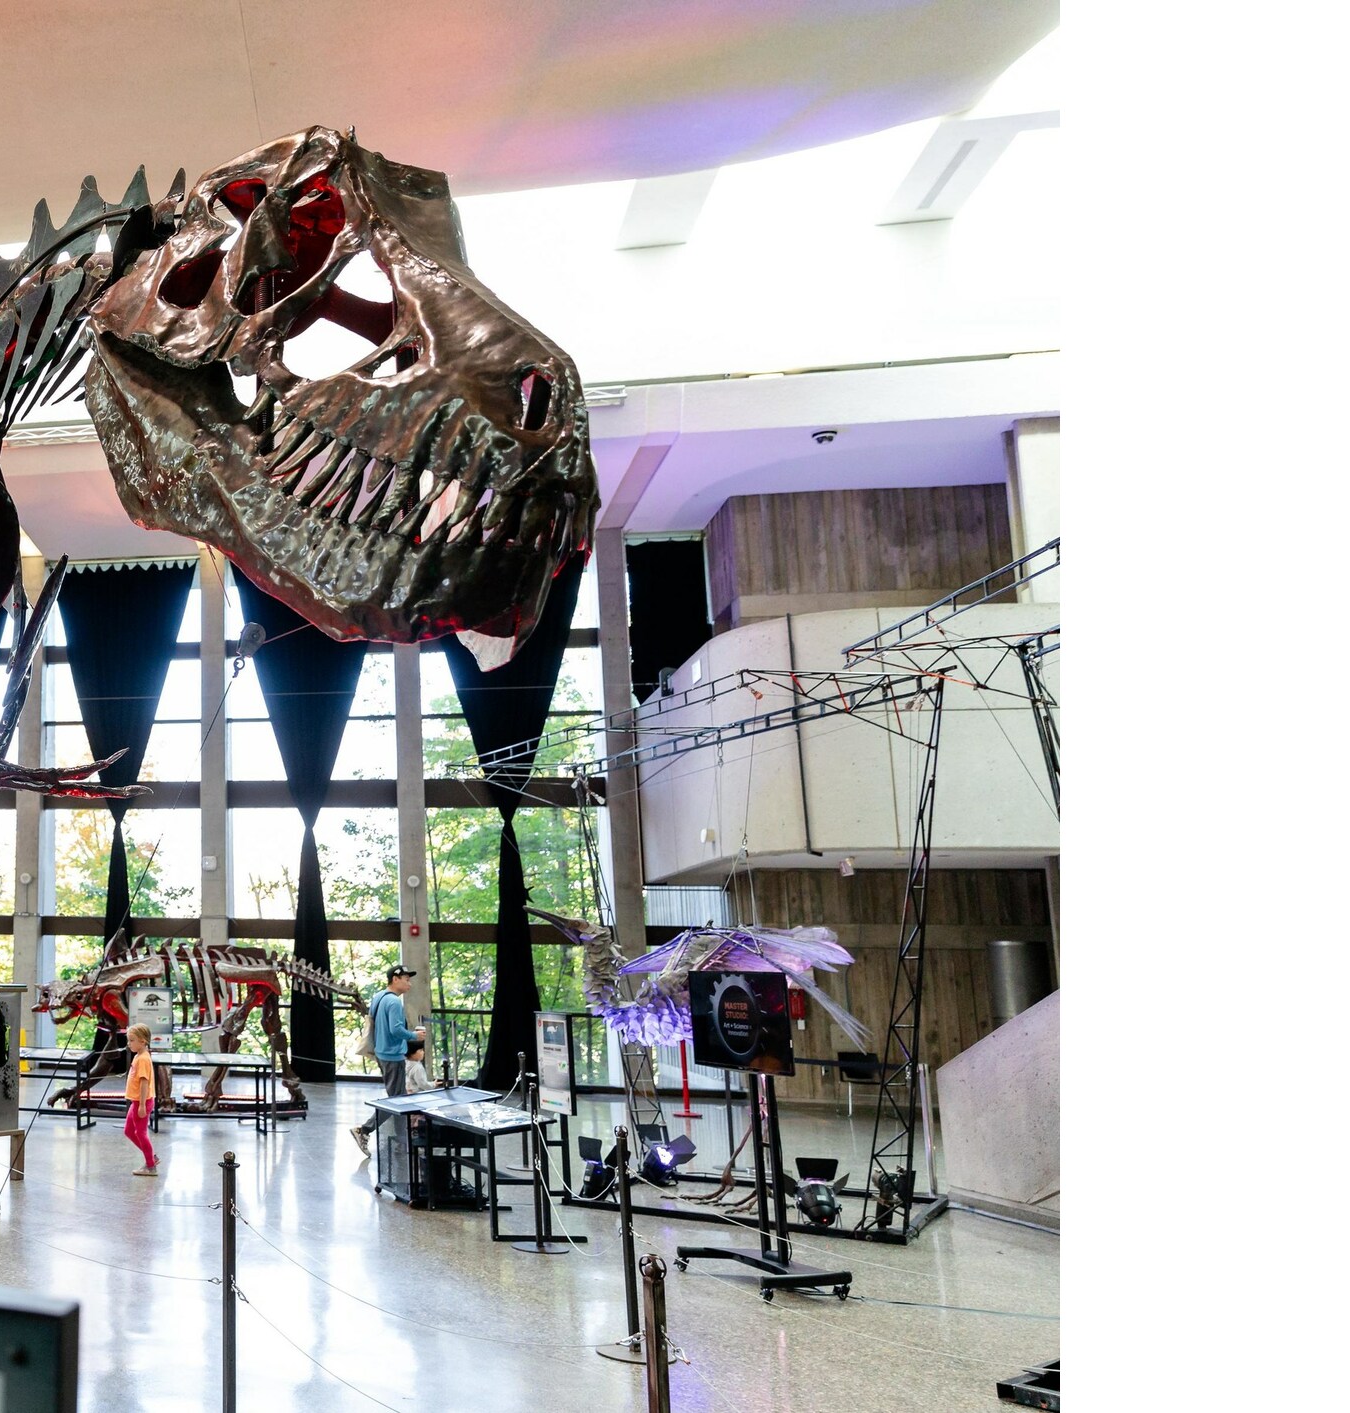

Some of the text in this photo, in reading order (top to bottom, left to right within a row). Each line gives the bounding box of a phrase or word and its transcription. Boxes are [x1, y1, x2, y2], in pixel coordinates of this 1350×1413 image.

[724, 1001, 748, 1011] MASTER
[725, 1011, 749, 1019] STUDIO:
[733, 1022, 749, 1030] Science
